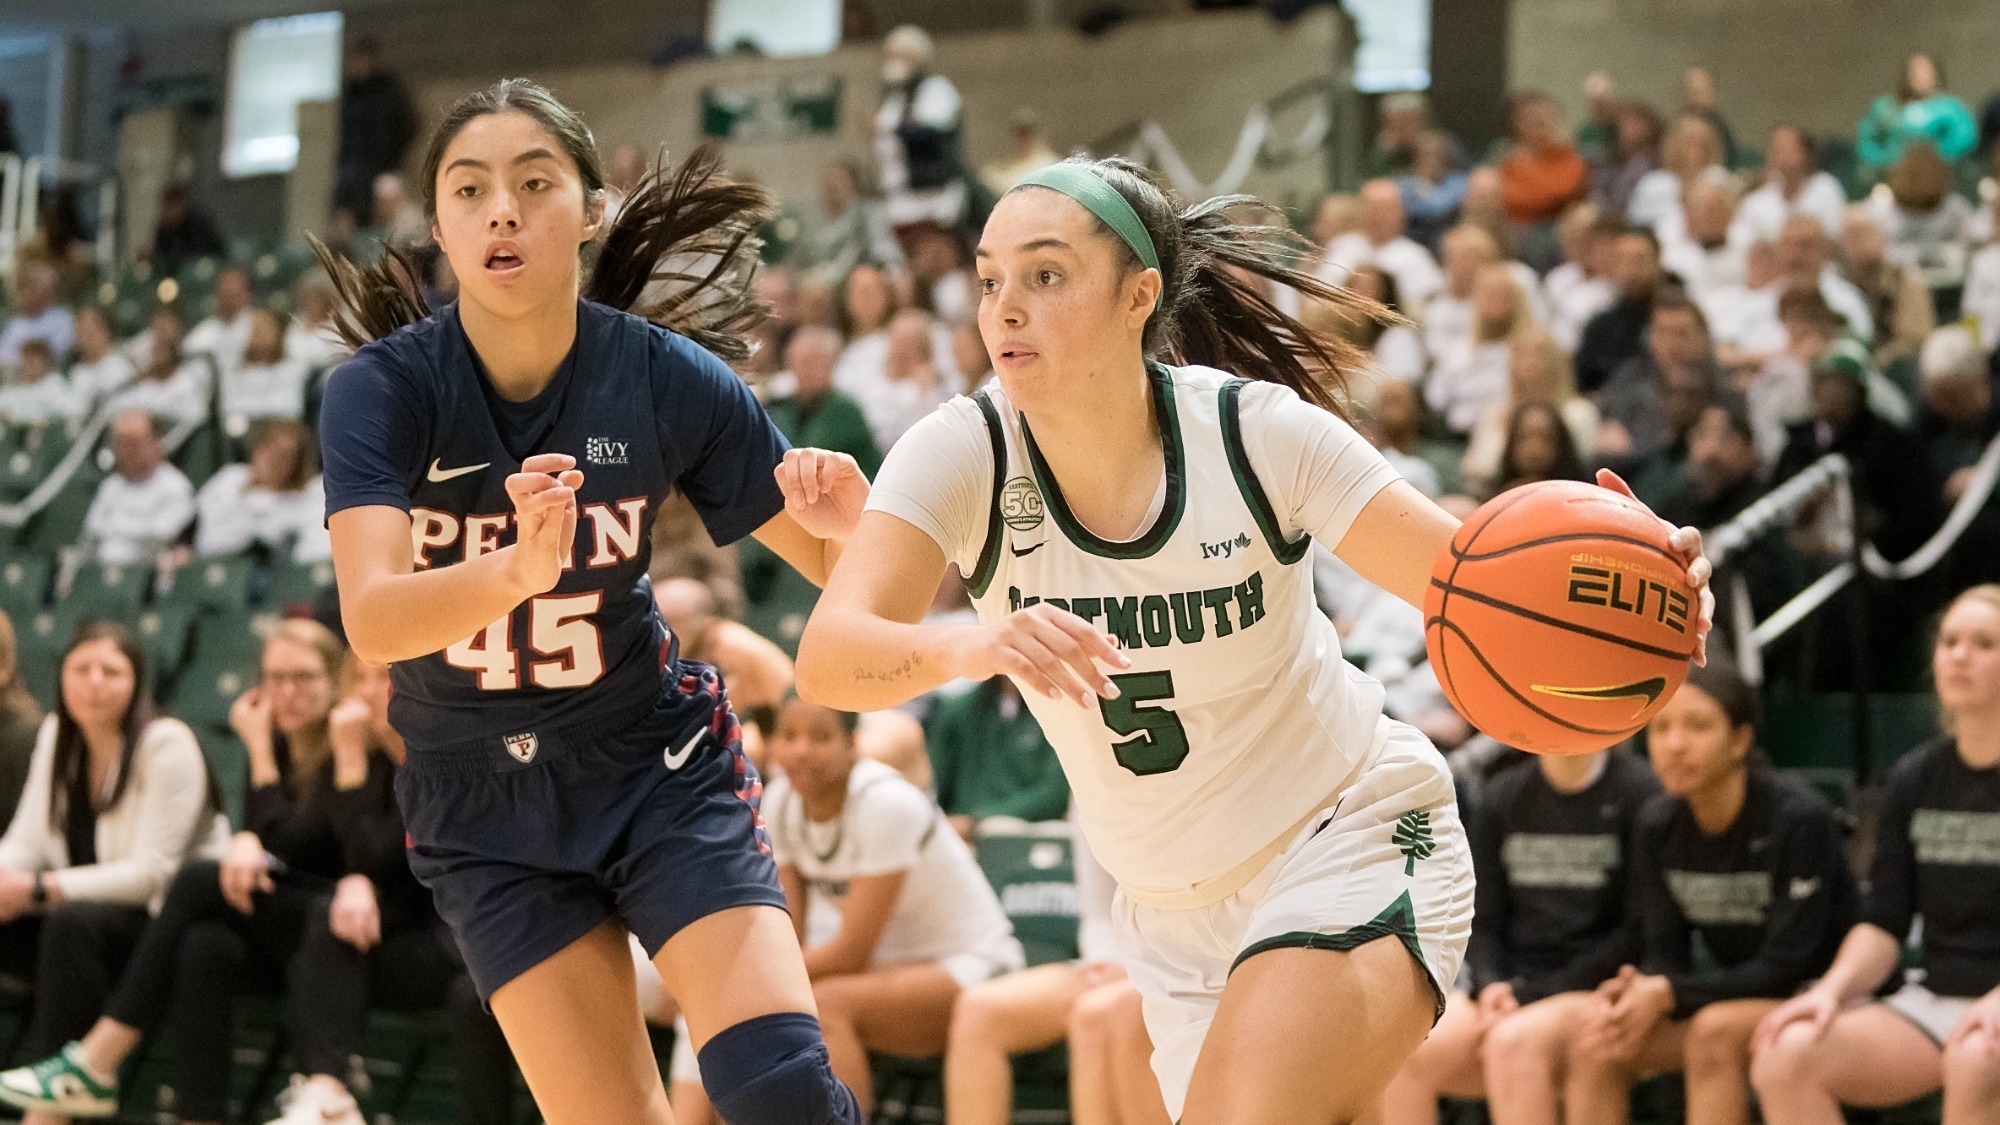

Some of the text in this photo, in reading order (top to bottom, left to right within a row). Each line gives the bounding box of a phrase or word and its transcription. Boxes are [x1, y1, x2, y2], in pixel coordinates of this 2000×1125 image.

[598, 442, 629, 457] IVY
[598, 456, 629, 465] LEAGUE
[410, 496, 649, 571] PEN
[1200, 539, 1232, 559] Ivy
[1008, 571, 1266, 650] TMOUTH
[1568, 564, 1690, 634] ELITE
[444, 588, 606, 692] 45
[507, 732, 531, 744] PENN
[1096, 669, 1190, 777] 5
[517, 741, 530, 757] P
